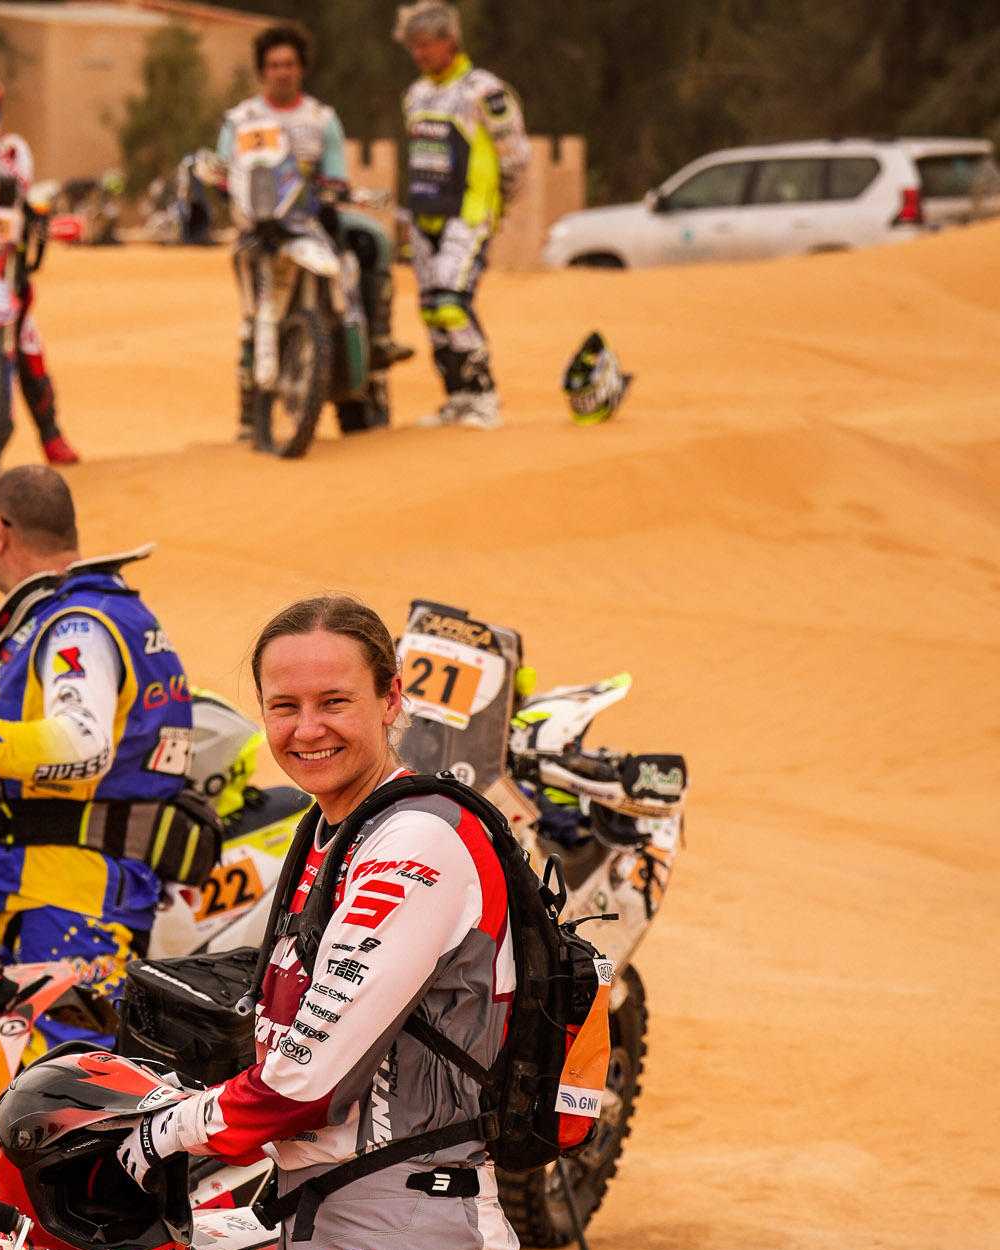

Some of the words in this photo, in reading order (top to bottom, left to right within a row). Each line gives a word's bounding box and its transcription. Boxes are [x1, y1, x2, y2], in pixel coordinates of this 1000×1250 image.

[406, 657, 459, 704] 21
[351, 858, 441, 885] FANTIC
[396, 870, 435, 887] RACING
[201, 869, 255, 917] 22
[578, 1096, 599, 1112] GNV
